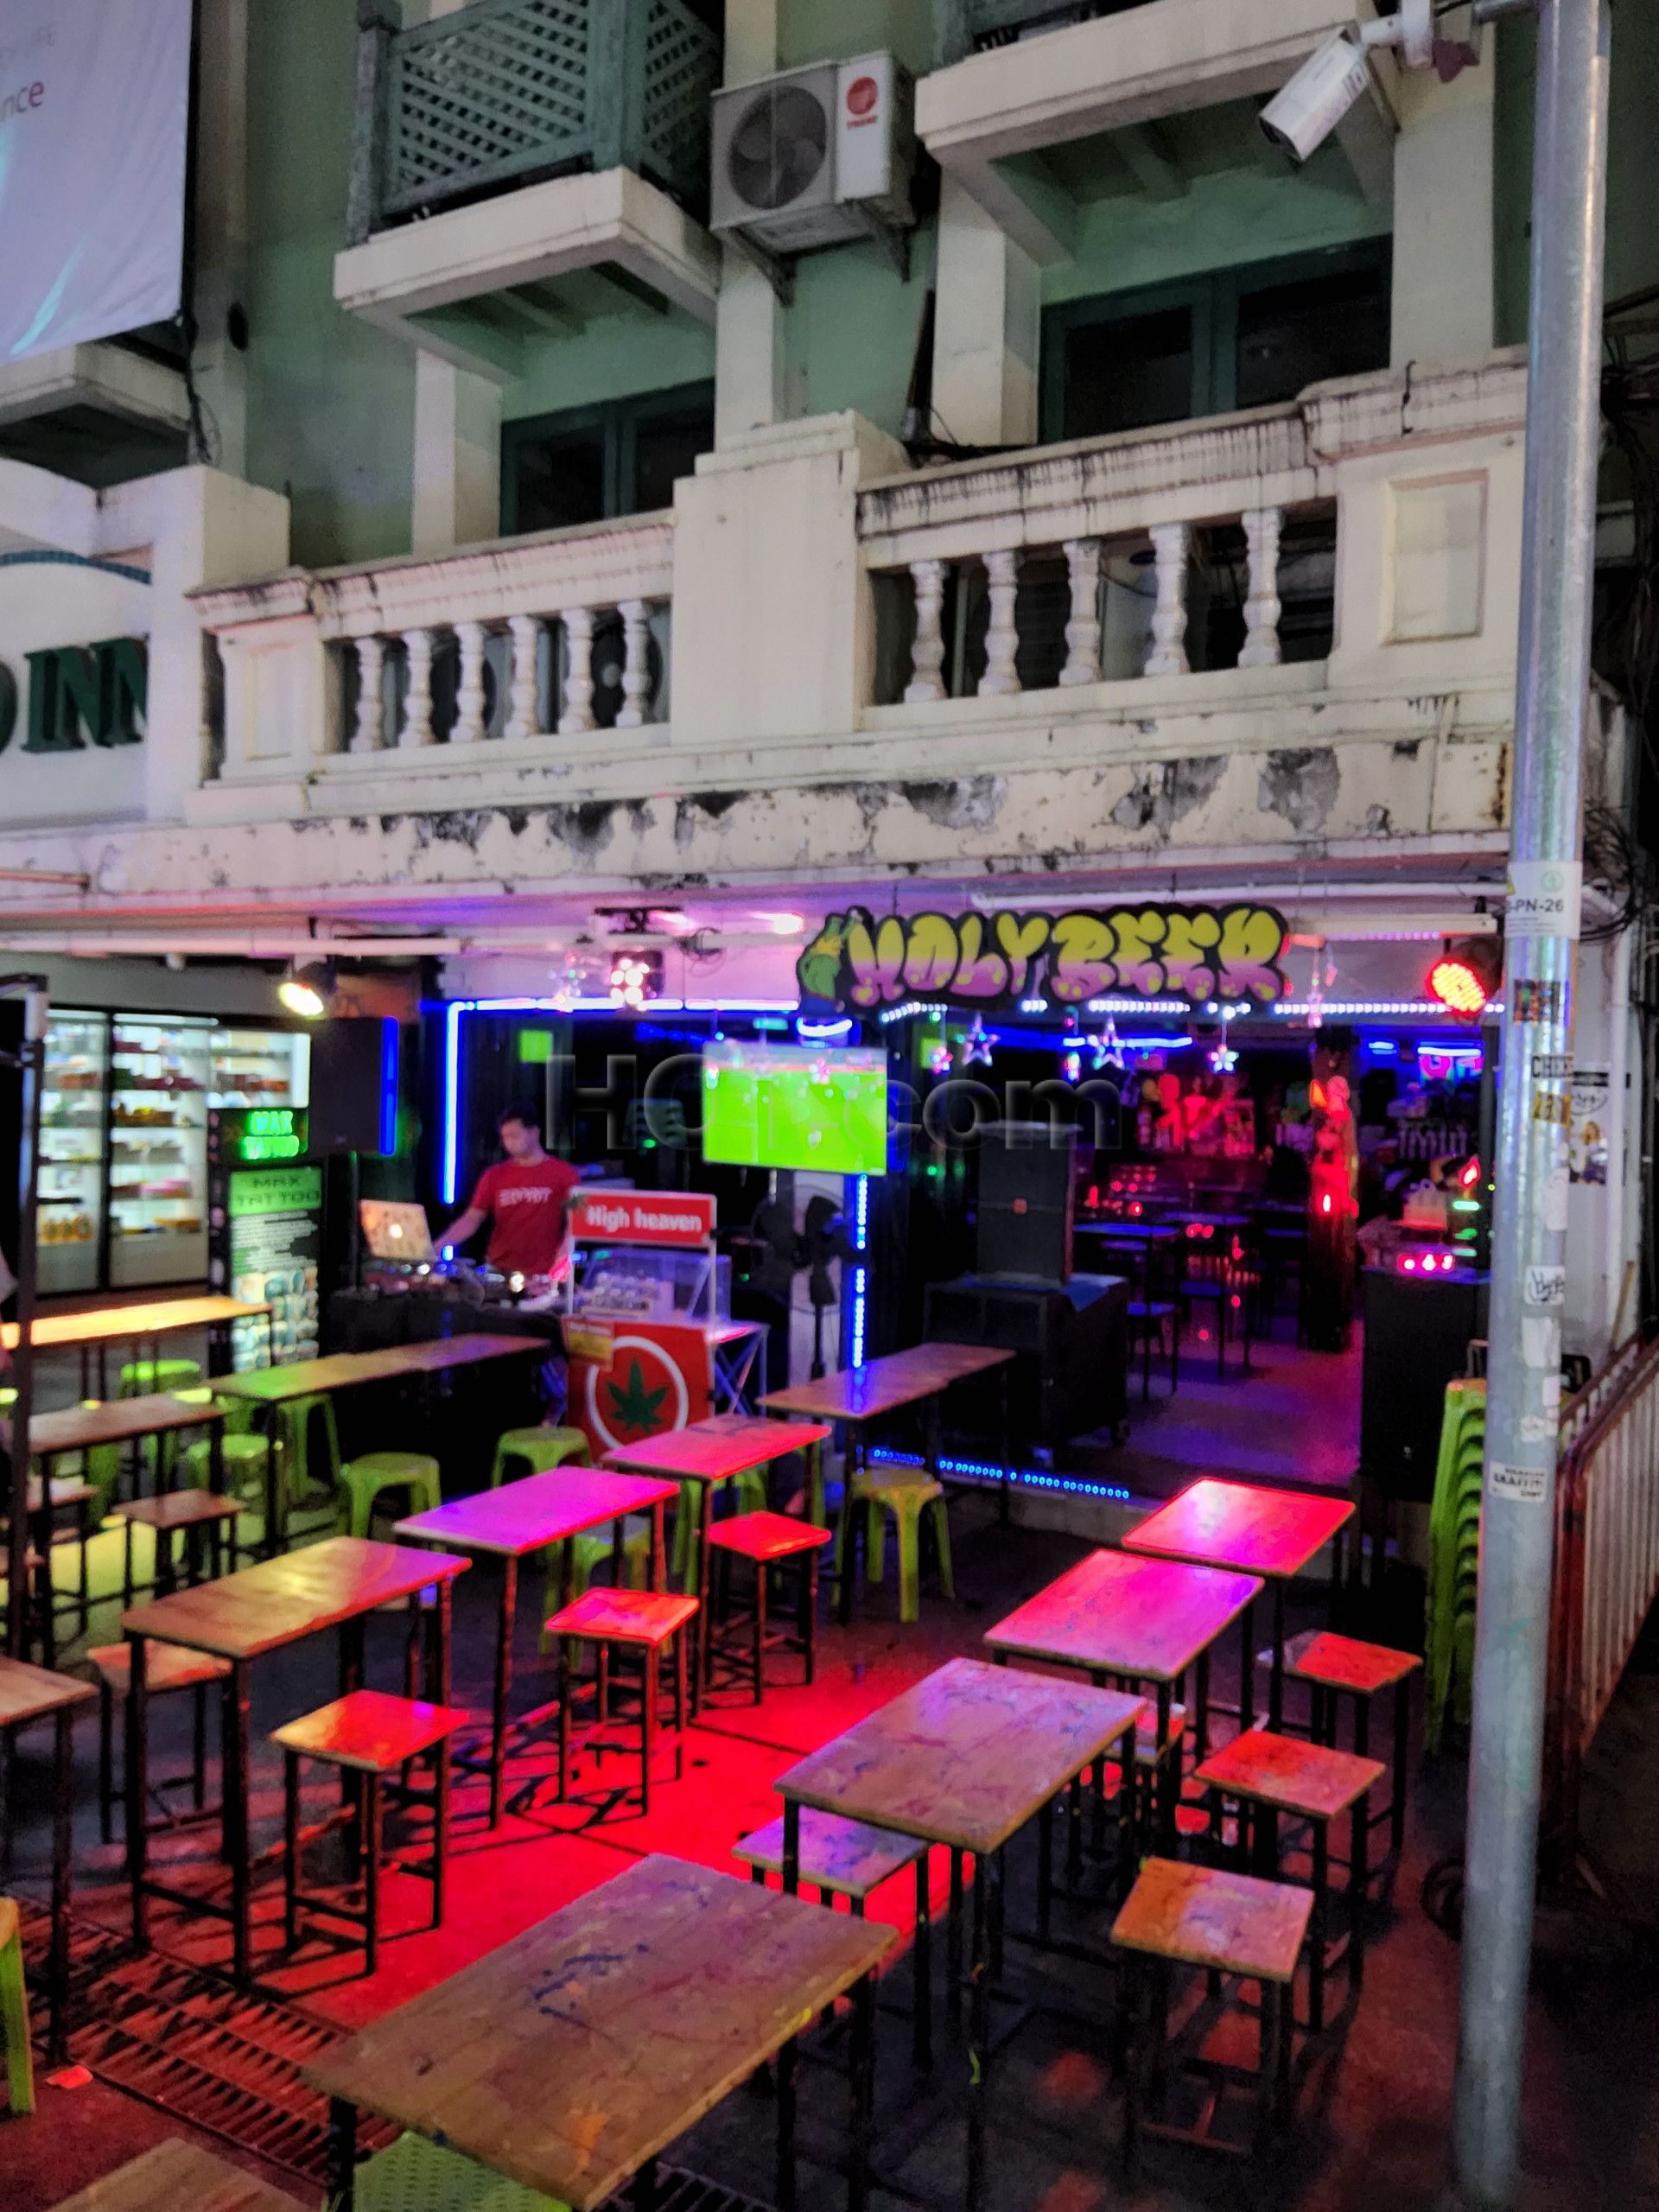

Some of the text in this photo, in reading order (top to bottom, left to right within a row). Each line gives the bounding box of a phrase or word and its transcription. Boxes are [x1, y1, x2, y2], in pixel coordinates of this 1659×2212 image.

[846, 906, 1282, 1007] HOLY BEER
[586, 1205, 702, 1234] High heaven
